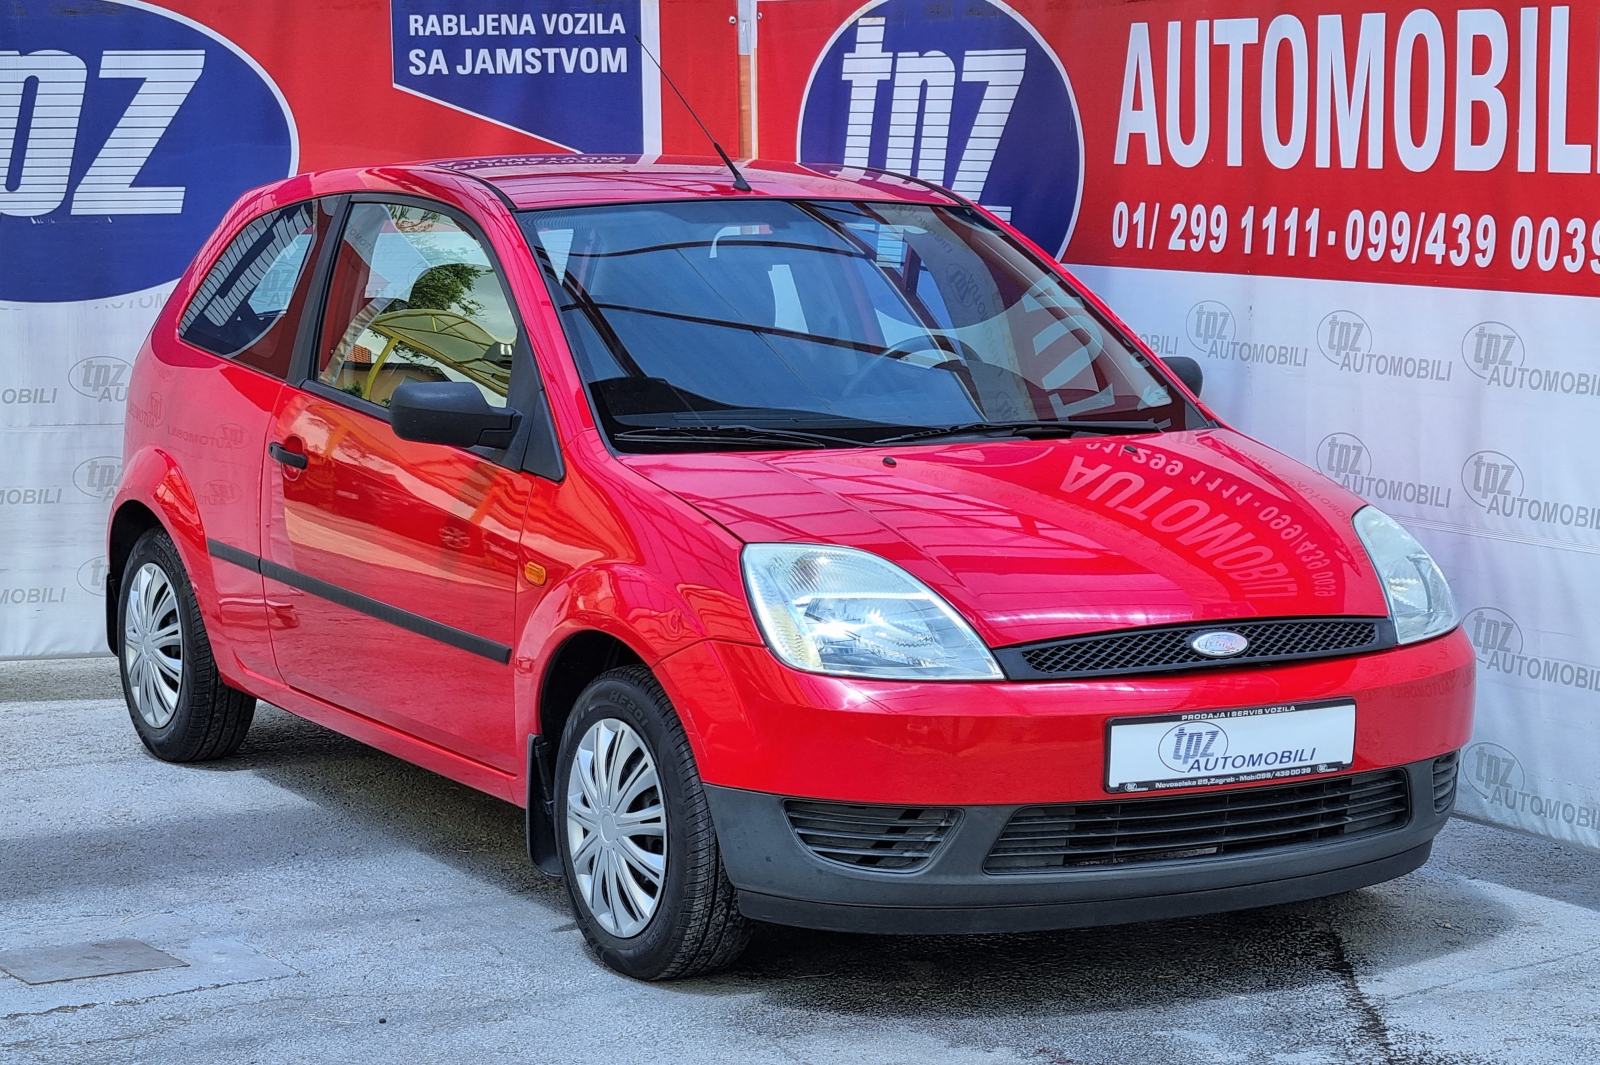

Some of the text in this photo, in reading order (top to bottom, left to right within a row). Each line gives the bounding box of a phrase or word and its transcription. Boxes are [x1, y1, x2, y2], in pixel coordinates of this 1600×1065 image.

[409, 13, 626, 36] RABLJENA VOZILA
[408, 47, 628, 75] SA JAMSTVOM
[1113, 5, 1600, 174] AUTOMOBIL
[1168, 203, 1228, 254] 299
[1195, 305, 1230, 344] tpz
[1328, 315, 1365, 356] tpz
[1208, 340, 1308, 367] AUTOMOBILI
[1340, 352, 1453, 381] AUTOMOBILI
[1473, 326, 1516, 370] tpz
[82, 360, 127, 392] tpz
[1327, 437, 1364, 478] tpz
[1341, 474, 1452, 508] AUTOMOBILI
[1473, 455, 1515, 499] tpz
[1473, 612, 1515, 654] tpz
[1181, 711, 1226, 721] PRODAJA
[1264, 705, 1296, 714] VOZILA
[1172, 727, 1219, 765] tpz
[1187, 748, 1316, 773] AUTOMOBILI
[1475, 746, 1516, 789] tpz
